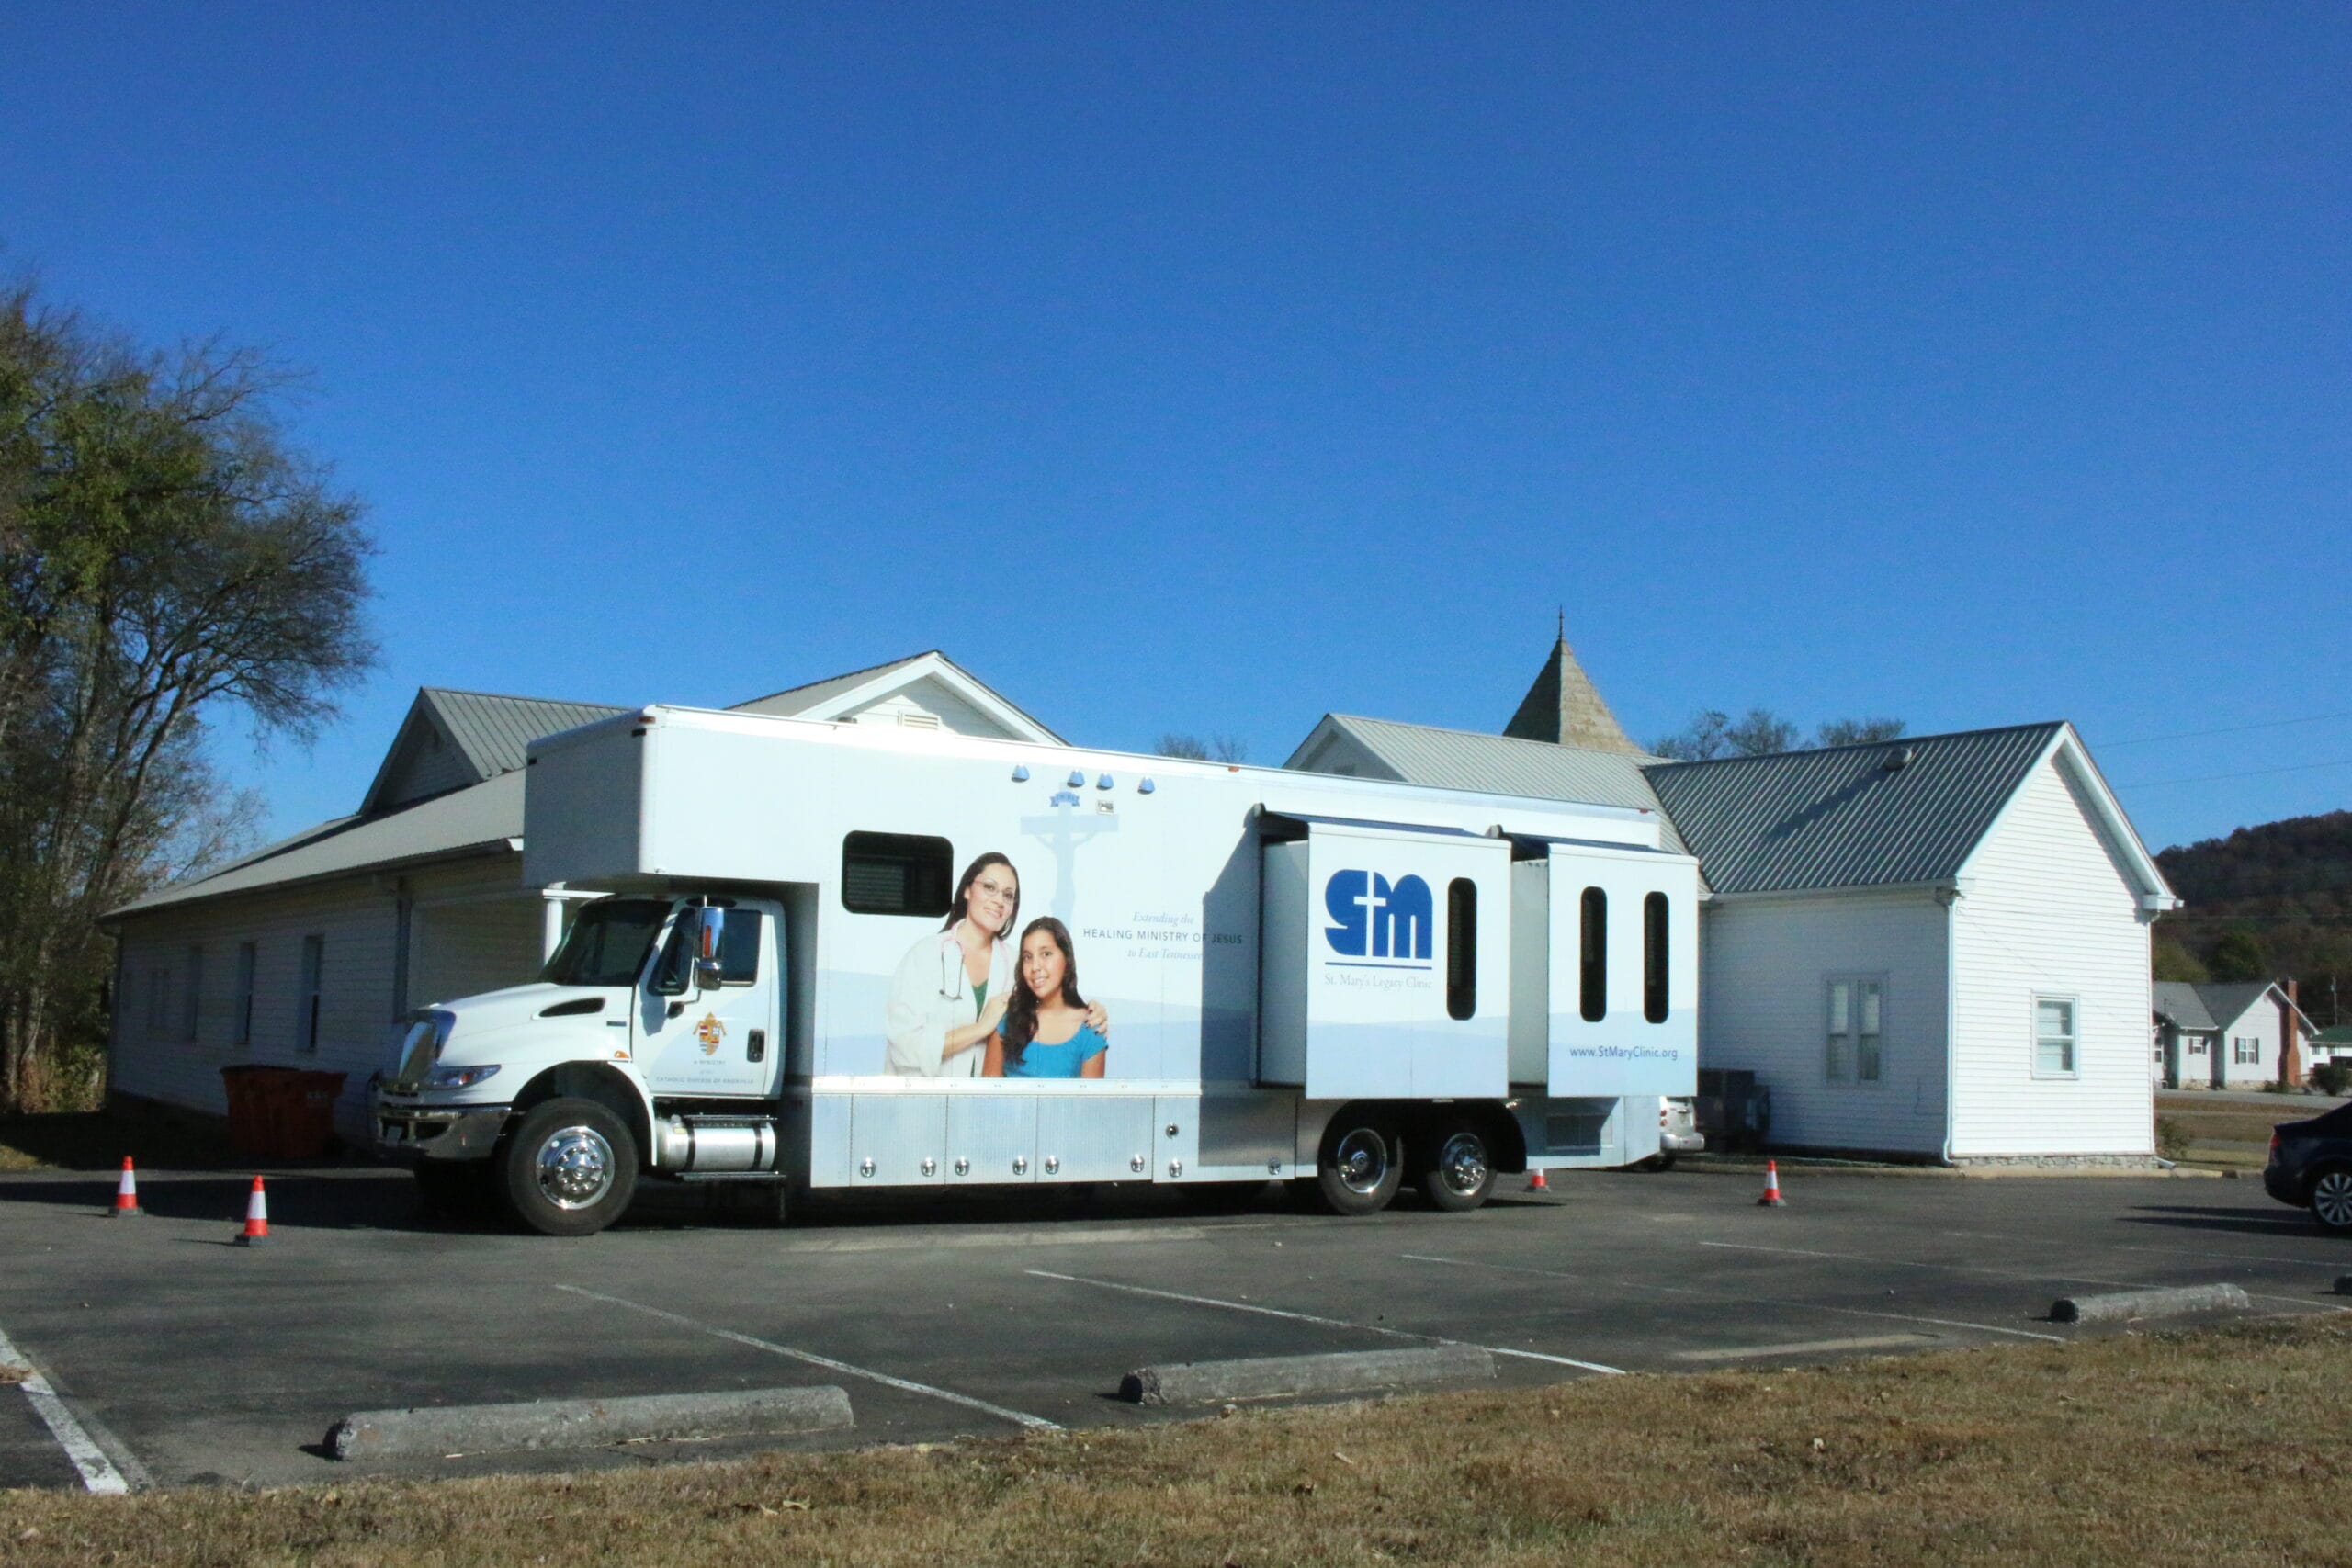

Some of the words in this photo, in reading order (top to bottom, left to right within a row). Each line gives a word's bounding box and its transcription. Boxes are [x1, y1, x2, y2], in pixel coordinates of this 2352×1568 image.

[1132, 911, 1179, 927] Extending
[1181, 913, 1194, 925] the
[1083, 928, 1133, 940] HEALING
[1137, 930, 1189, 942] MINISTRY
[1193, 932, 1207, 943] OF
[1211, 933, 1243, 945] JESUS
[1127, 949, 1137, 959] to
[1138, 947, 1159, 959] East
[1324, 973, 1338, 986] St.
[1340, 974, 1370, 990] Mary's
[1373, 975, 1404, 991] Legacy
[1406, 976, 1433, 989] Clinic
[1569, 1045, 1679, 1061] www.StMaryClinic.org
